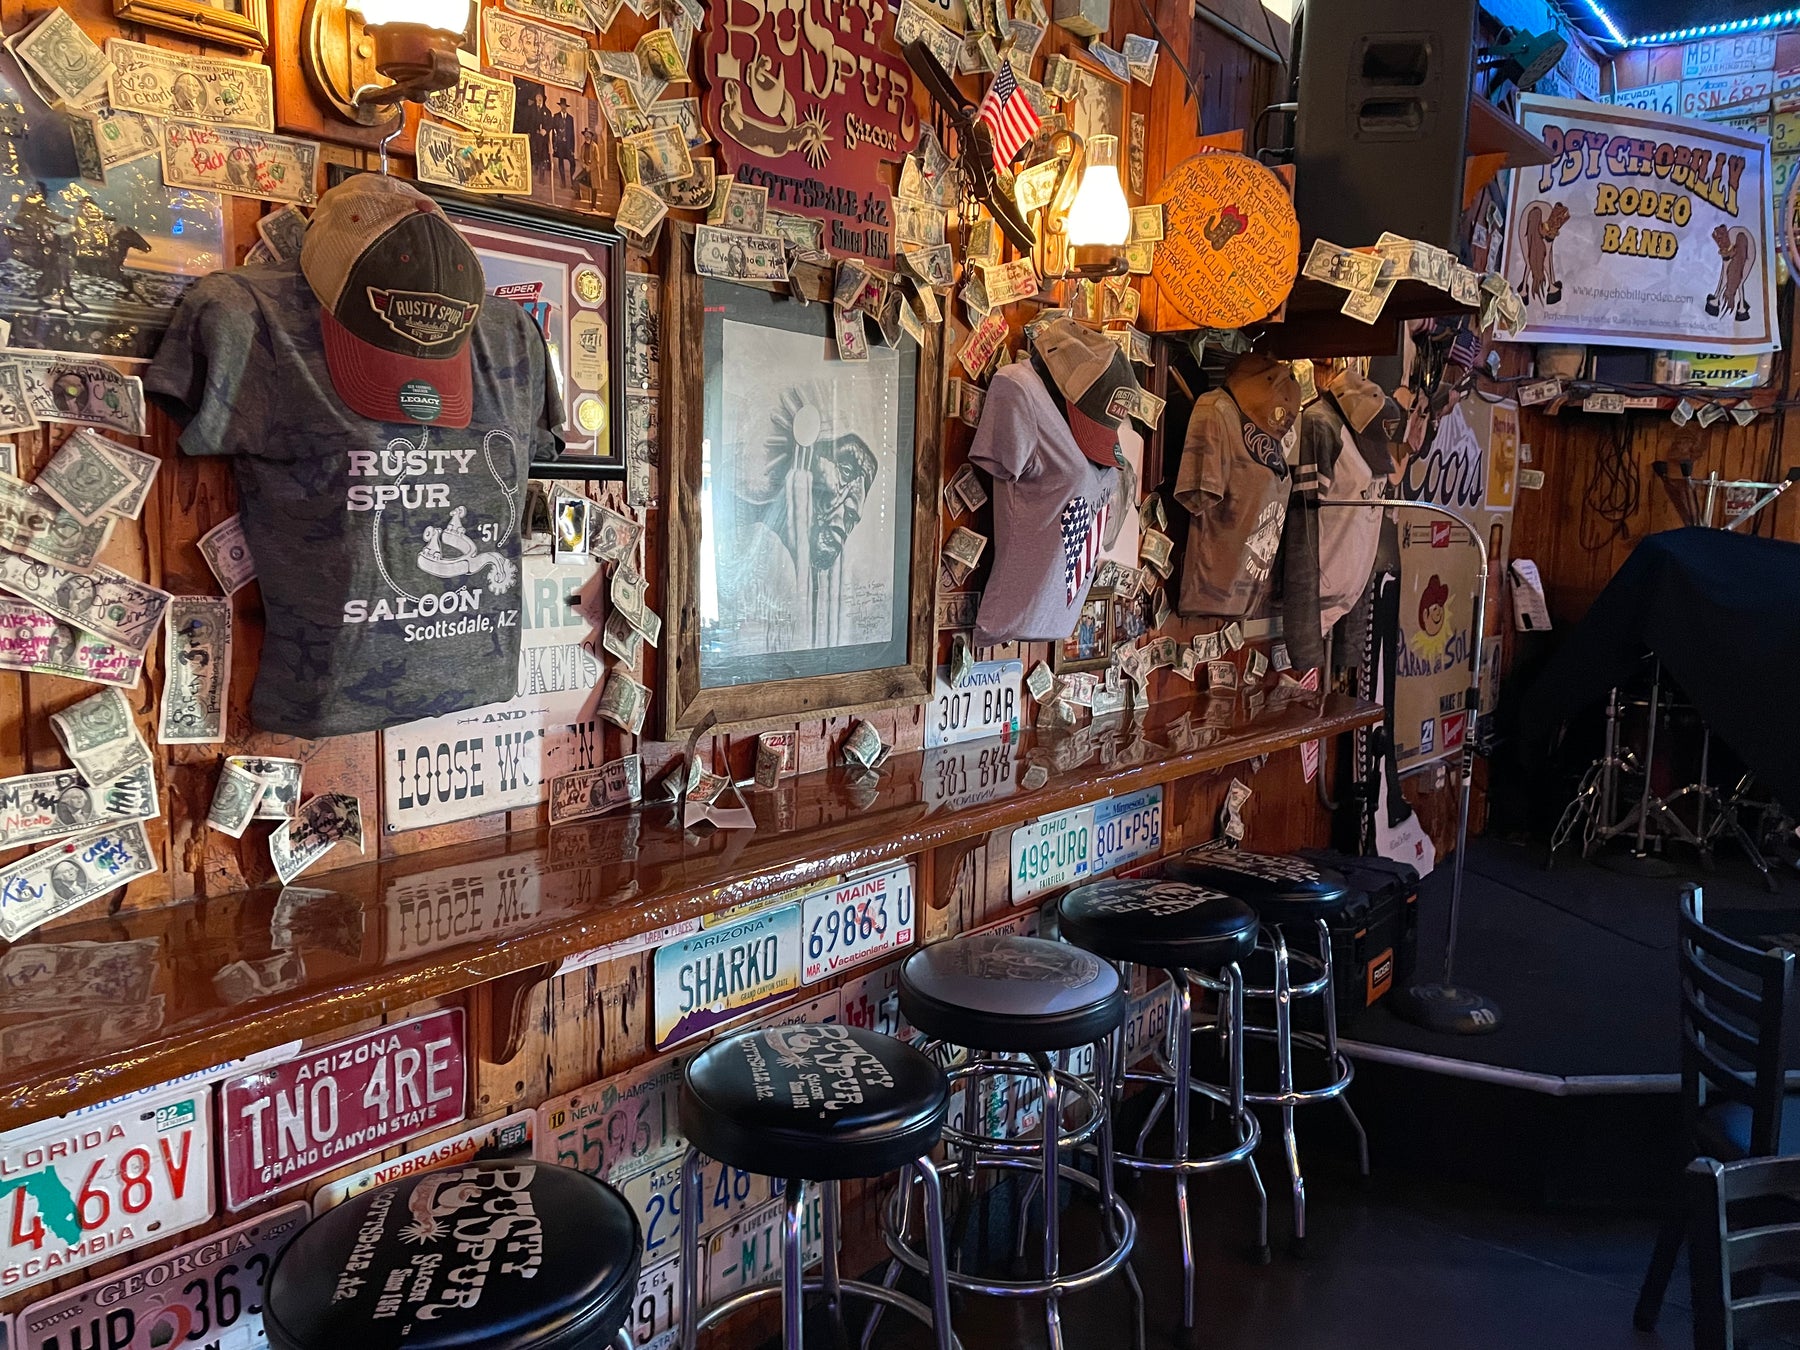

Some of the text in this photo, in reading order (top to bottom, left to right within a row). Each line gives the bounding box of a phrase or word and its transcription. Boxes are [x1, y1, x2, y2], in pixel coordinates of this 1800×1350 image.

[1616, 87, 1656, 102] NEVADA
[845, 112, 897, 152] SALOON
[1222, 165, 1246, 189] NATE
[1241, 164, 1262, 192] CAROL
[1538, 124, 1746, 217] PSYCHOBILLY
[1594, 183, 1692, 227] RODEO
[1241, 232, 1268, 256] DAVID
[1601, 223, 1679, 260] BAND
[1204, 253, 1227, 283] CLUB
[499, 283, 535, 295] SUPER
[395, 300, 463, 326] RUSTY SPUR
[400, 396, 440, 406] LEGACY
[347, 449, 477, 476] RUSTY
[1403, 449, 1484, 507] Coors
[347, 483, 451, 511] SPUR
[343, 588, 483, 624] SALOON
[403, 609, 519, 643] Scottsdale, AZ
[482, 709, 527, 724] AND
[938, 687, 1015, 732] 307 BAR
[397, 737, 484, 810] LOOSE
[1112, 797, 1145, 814] Minnesota
[1040, 817, 1067, 837] OHIO
[1097, 806, 1160, 858] 801 PSG
[1017, 826, 1089, 883] 498 URQ
[835, 877, 887, 905] MAINE
[1039, 871, 1065, 890] FAIRFIELD
[692, 920, 765, 952] ARIZONA
[808, 893, 889, 959] 69863
[898, 930, 911, 944] 94
[678, 934, 779, 1013] SHARKO
[806, 939, 890, 978] MAR Vacationland
[775, 977, 788, 988] STATE
[295, 1035, 402, 1083] ARIZONA
[240, 1037, 453, 1169] TNO 4RE
[571, 1103, 599, 1121] NEW
[617, 1070, 681, 1103] HAMPSHIRE
[157, 1105, 180, 1123] 92
[260, 1106, 438, 1183] GRAND CANYON STATE
[373, 1136, 477, 1187] NEBRASKA
[94, 1231, 255, 1307] GEORGIA
